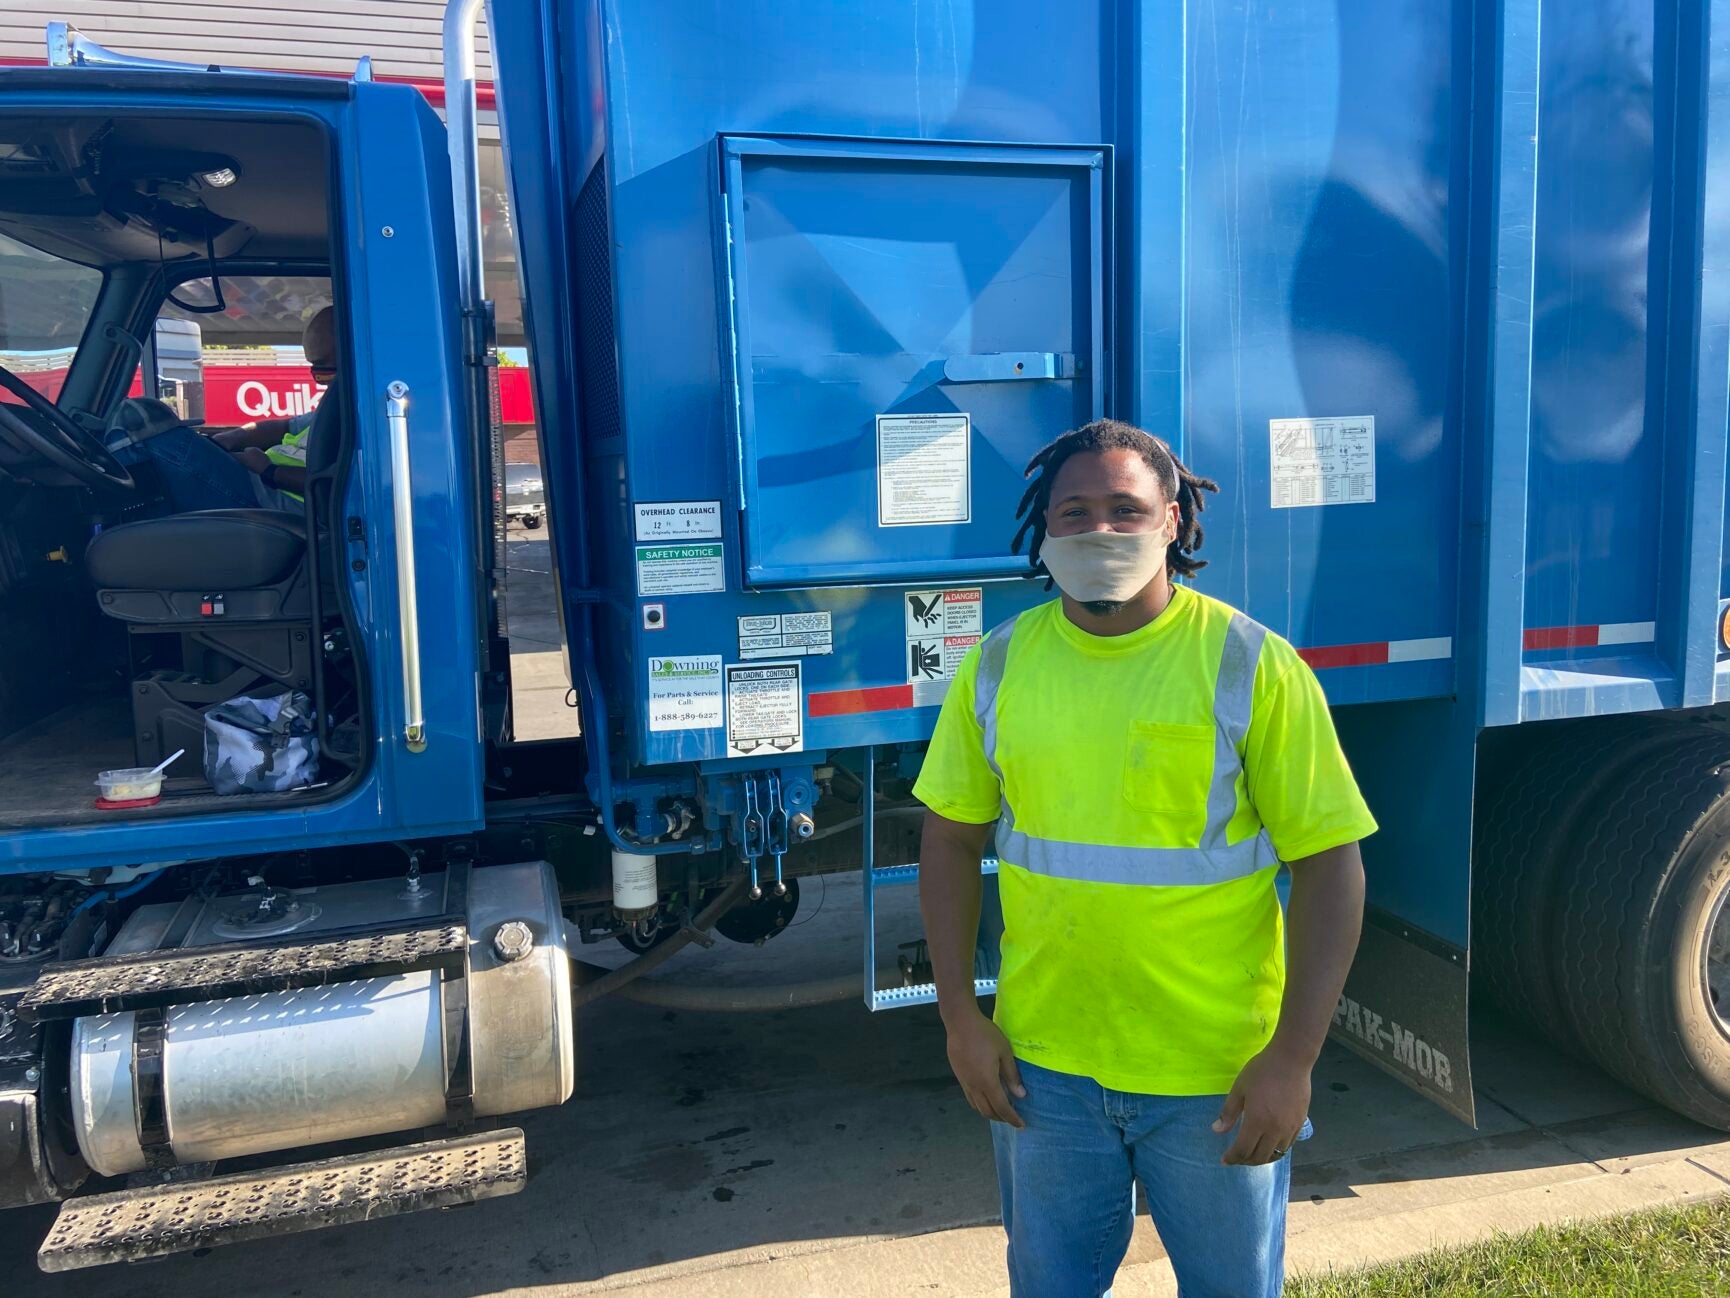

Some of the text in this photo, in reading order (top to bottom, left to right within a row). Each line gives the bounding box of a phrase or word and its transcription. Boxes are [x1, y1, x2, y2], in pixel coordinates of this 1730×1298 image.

[236, 380, 328, 418] Quik
[640, 507, 716, 517] OVERHEAD CLEARANCE
[645, 549, 714, 559] SAFETY NOTICE
[951, 593, 980, 601] DANGER
[951, 637, 980, 646] DANGER
[651, 657, 720, 675] Downing
[732, 670, 795, 680] UNLOADING CONTROLS
[654, 713, 719, 722] 1-888-589-6227
[1332, 992, 1454, 1093] PAK-MOR
